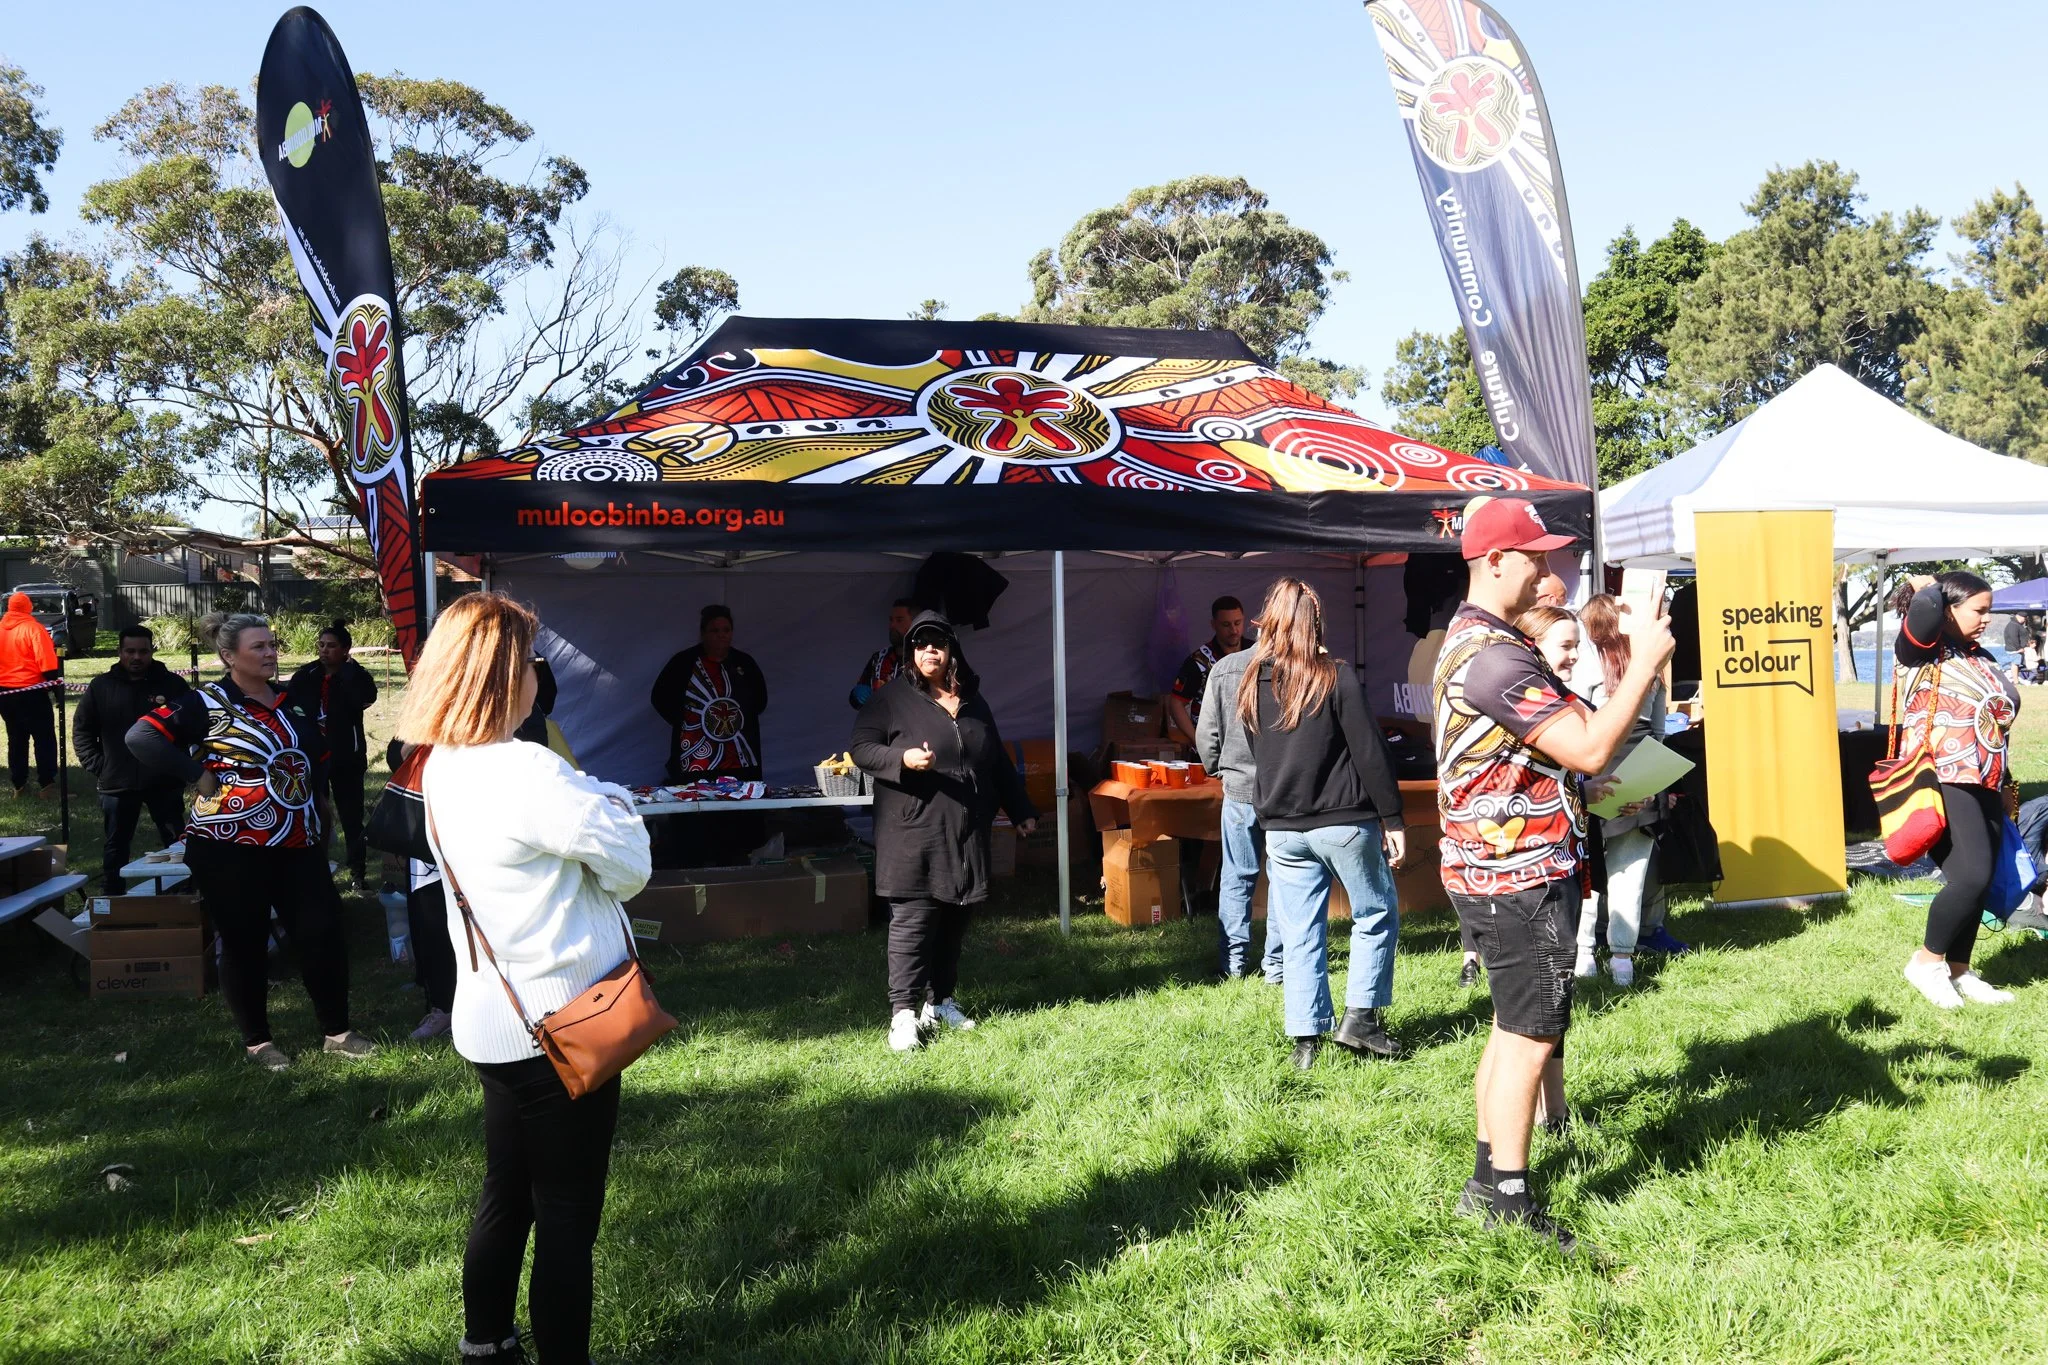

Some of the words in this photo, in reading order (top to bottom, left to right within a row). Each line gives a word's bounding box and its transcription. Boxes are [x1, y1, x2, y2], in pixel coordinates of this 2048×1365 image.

[517, 501, 784, 532] muloobinba.org.au
[1722, 600, 1822, 628] speaking
[1723, 629, 1744, 652] in
[1724, 650, 1800, 674] colour
